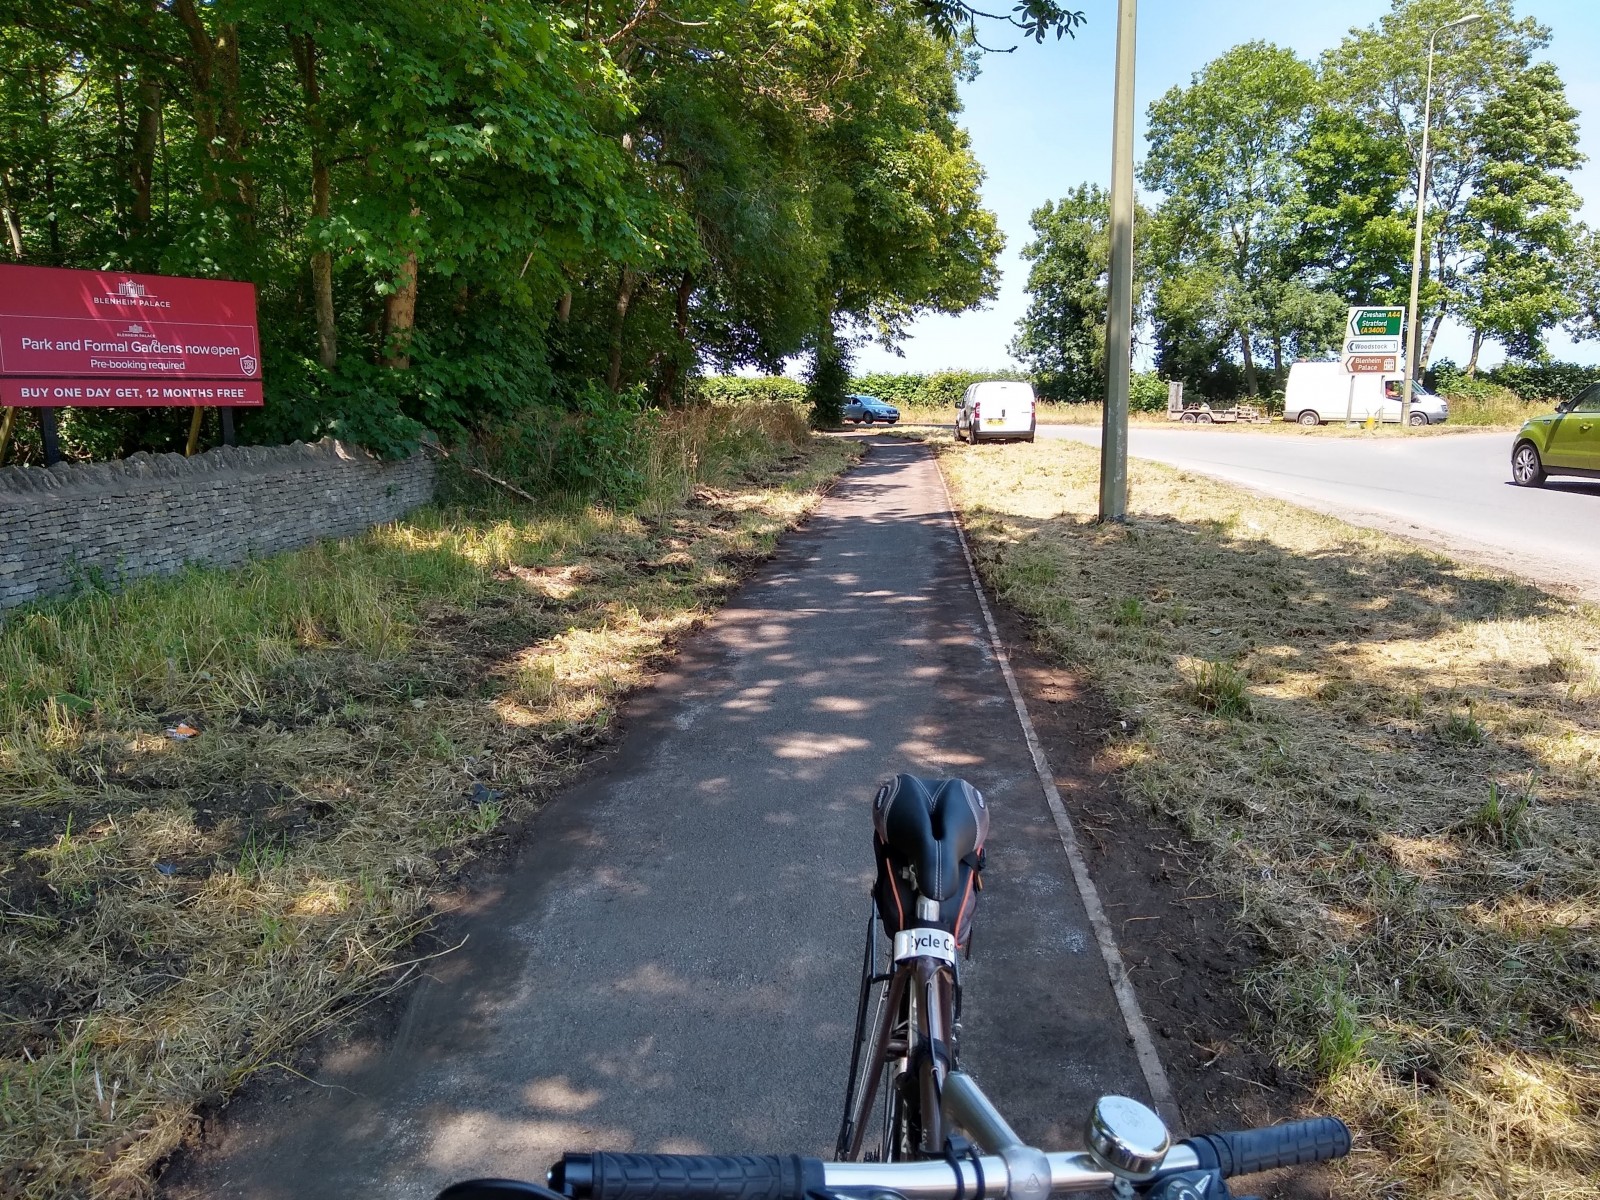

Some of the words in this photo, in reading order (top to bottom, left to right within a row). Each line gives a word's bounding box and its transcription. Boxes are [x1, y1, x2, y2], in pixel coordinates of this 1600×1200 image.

[93, 297, 137, 306] BLENHEIM
[139, 300, 171, 308] PALACE
[21, 337, 53, 351] Park
[55, 340, 81, 351] and
[84, 339, 128, 353] Formal
[131, 340, 183, 354] Gardens
[185, 345, 210, 355] now
[210, 346, 240, 357] open
[90, 359, 147, 371] Pre-booking
[148, 361, 186, 371] required
[21, 387, 49, 398] BUY
[53, 387, 82, 398] ONE
[86, 388, 111, 398] DAY
[115, 388, 143, 399] GET,
[145, 388, 159, 398] 12
[163, 388, 214, 398] MONTHS
